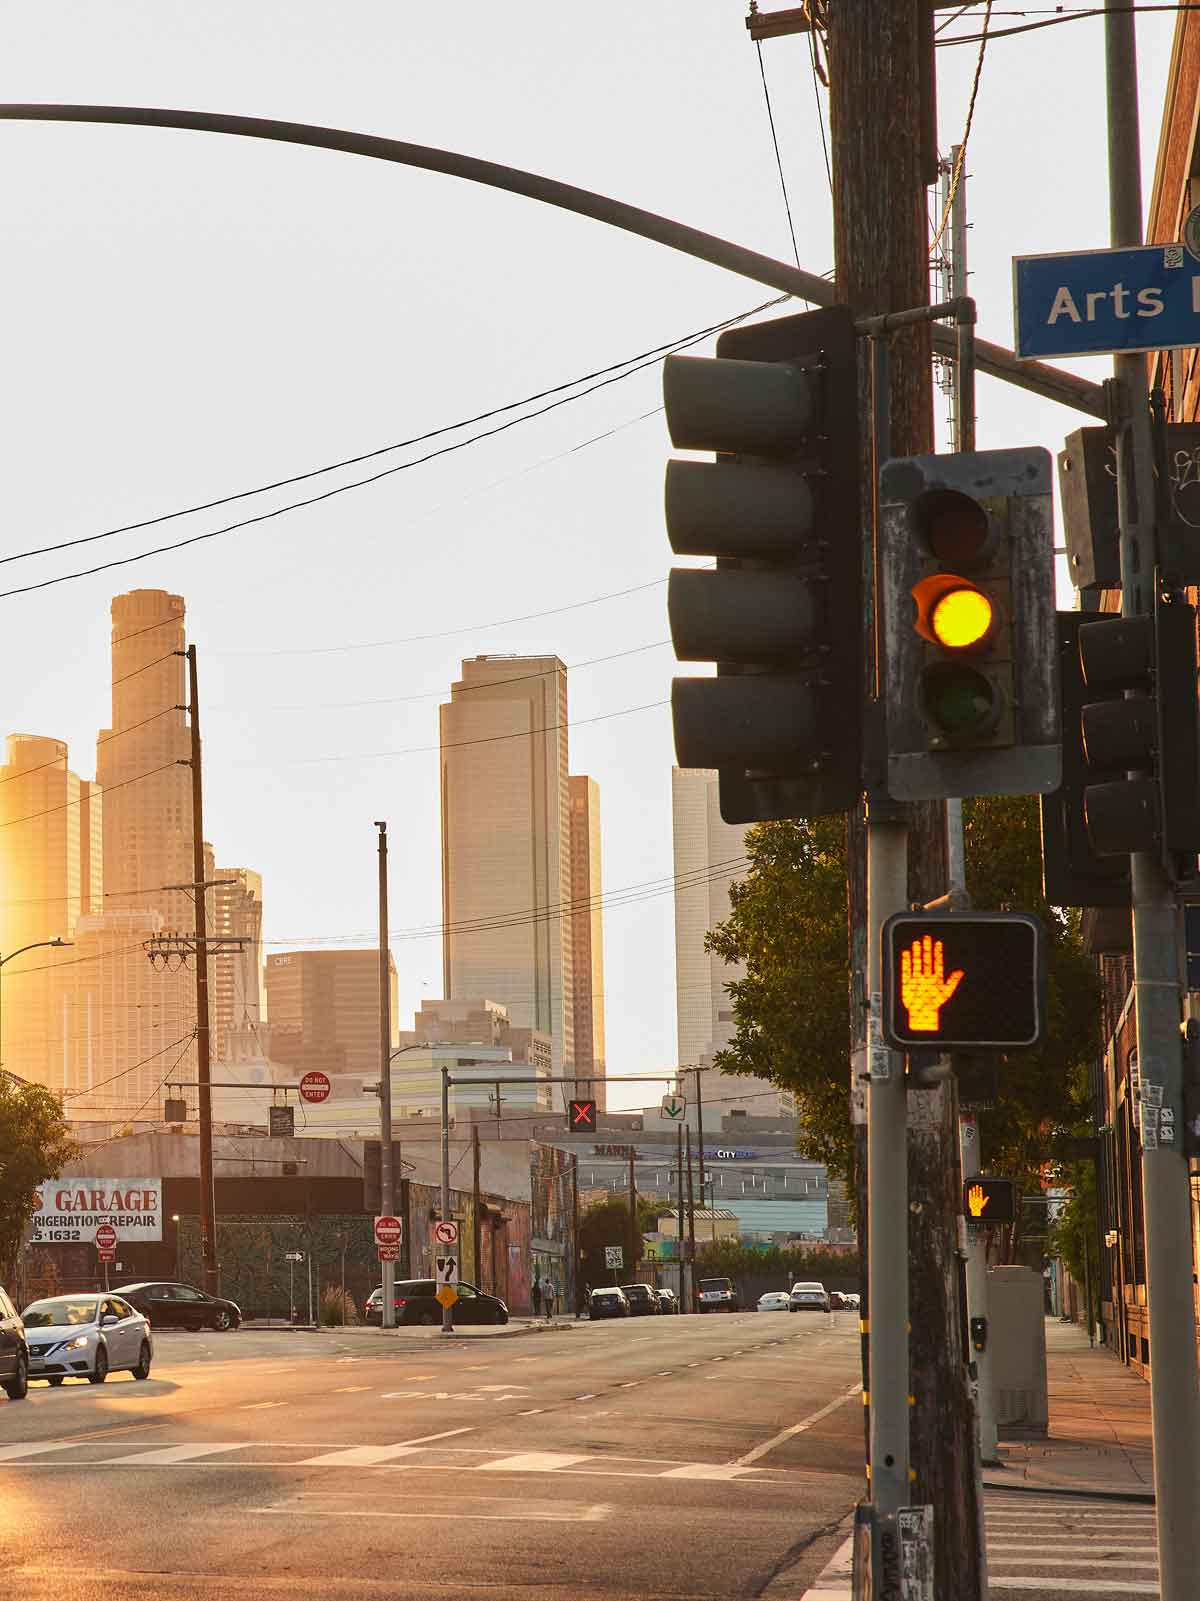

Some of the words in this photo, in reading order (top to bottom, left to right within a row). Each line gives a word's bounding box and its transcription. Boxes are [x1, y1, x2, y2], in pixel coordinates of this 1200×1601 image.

[1047, 282, 1165, 324] Arts
[55, 1190, 158, 1212] GARAGE
[109, 1215, 156, 1227] REPAIR
[380, 1392, 529, 1401] ONLY
